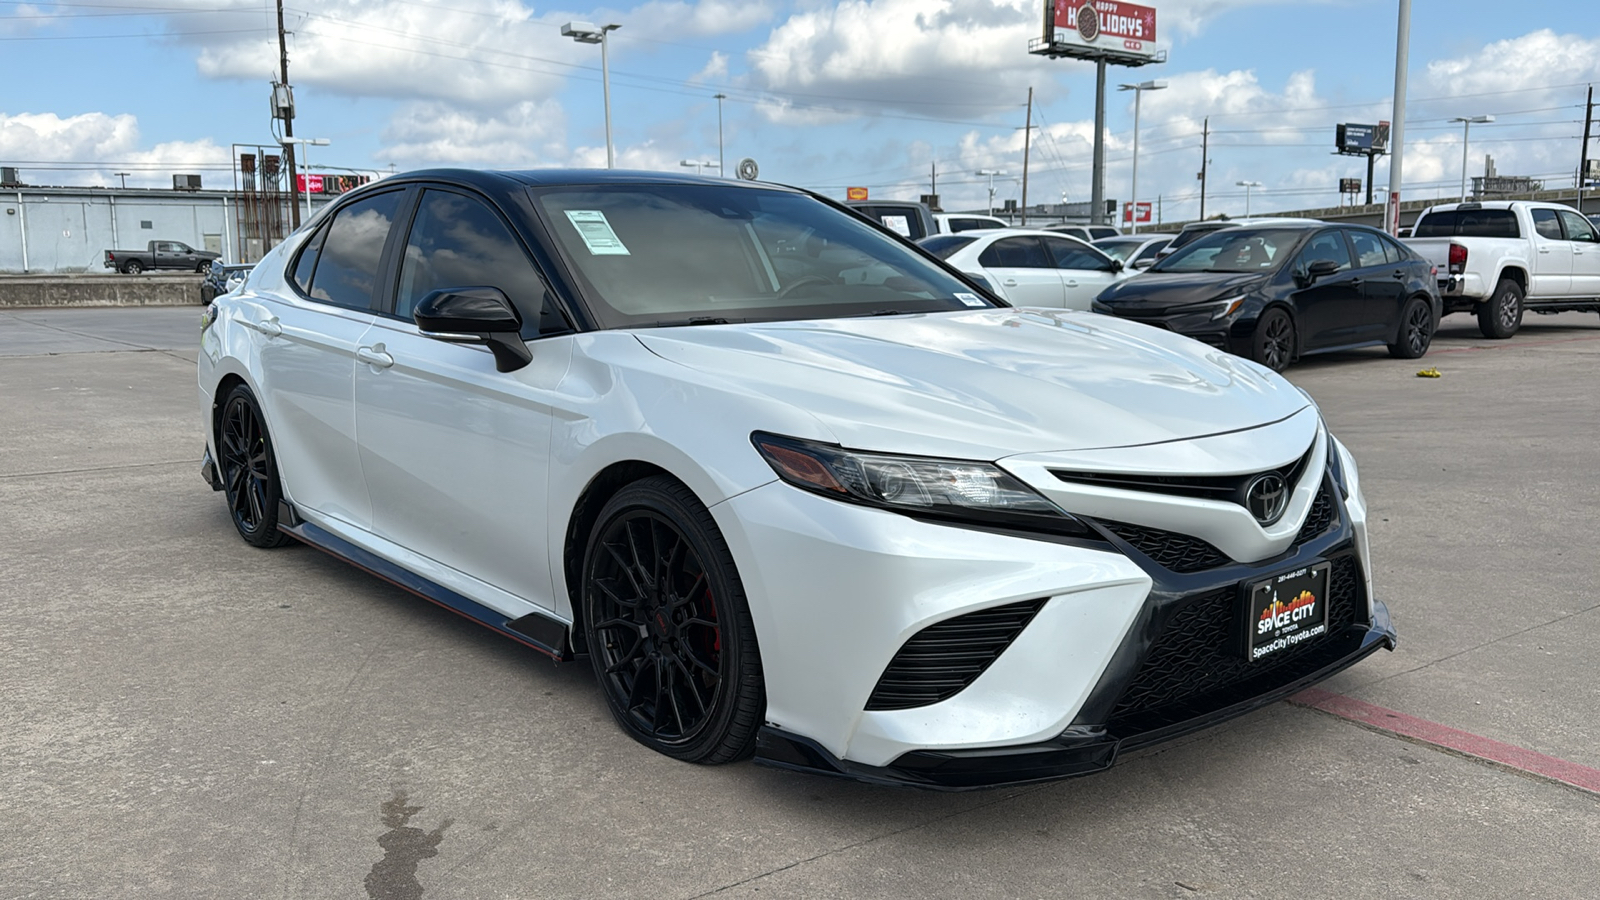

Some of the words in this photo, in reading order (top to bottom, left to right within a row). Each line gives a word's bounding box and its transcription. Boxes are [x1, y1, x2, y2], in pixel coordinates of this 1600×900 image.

[1096, 1, 1118, 13] HAPPY
[1258, 609, 1291, 634] SPACE
[1292, 602, 1316, 622] CITY
[1282, 624, 1299, 634] TOYOTA
[1253, 625, 1325, 658] SpaceCityToyota.com
